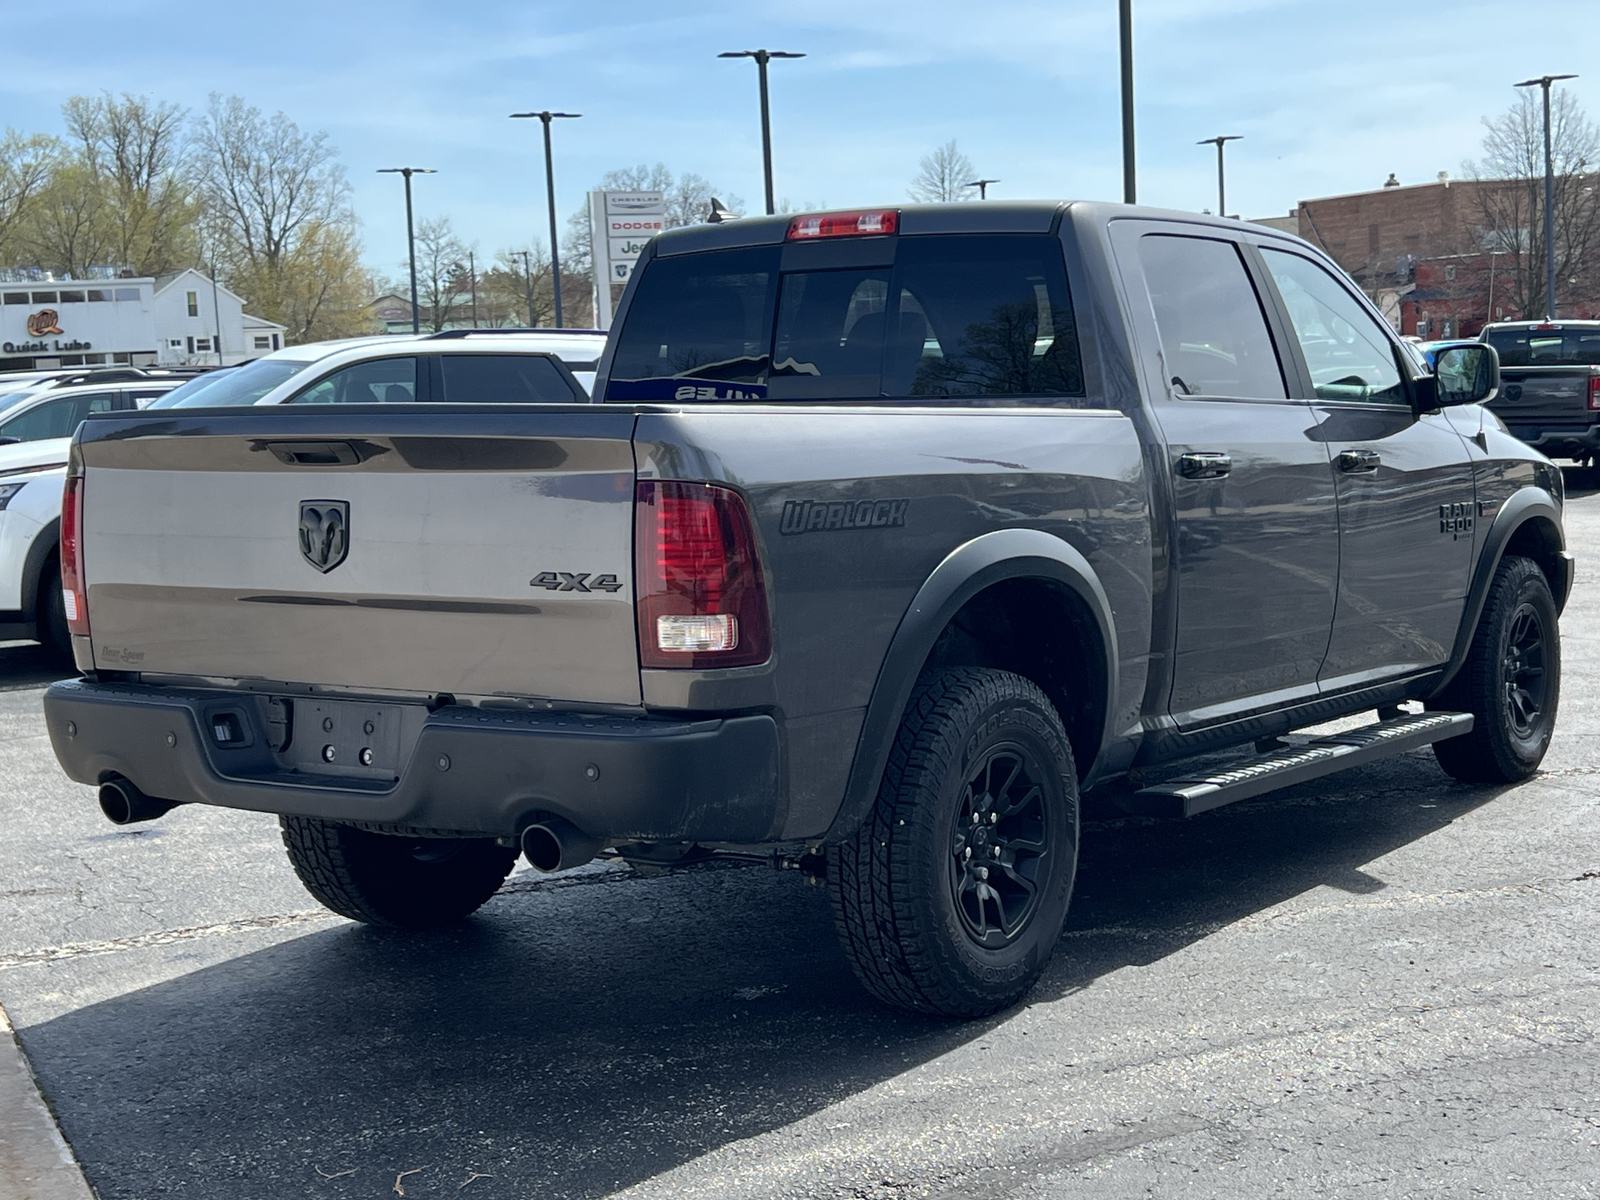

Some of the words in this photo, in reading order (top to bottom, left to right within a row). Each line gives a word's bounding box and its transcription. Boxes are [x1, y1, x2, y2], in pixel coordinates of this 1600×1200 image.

[612, 222, 662, 230] DODGE
[621, 240, 646, 254] Jee
[3, 341, 49, 353] Quick
[55, 339, 91, 351] Lube
[1440, 501, 1474, 518] RAM
[779, 499, 910, 536] WARLOCK
[1440, 517, 1473, 533] 1500
